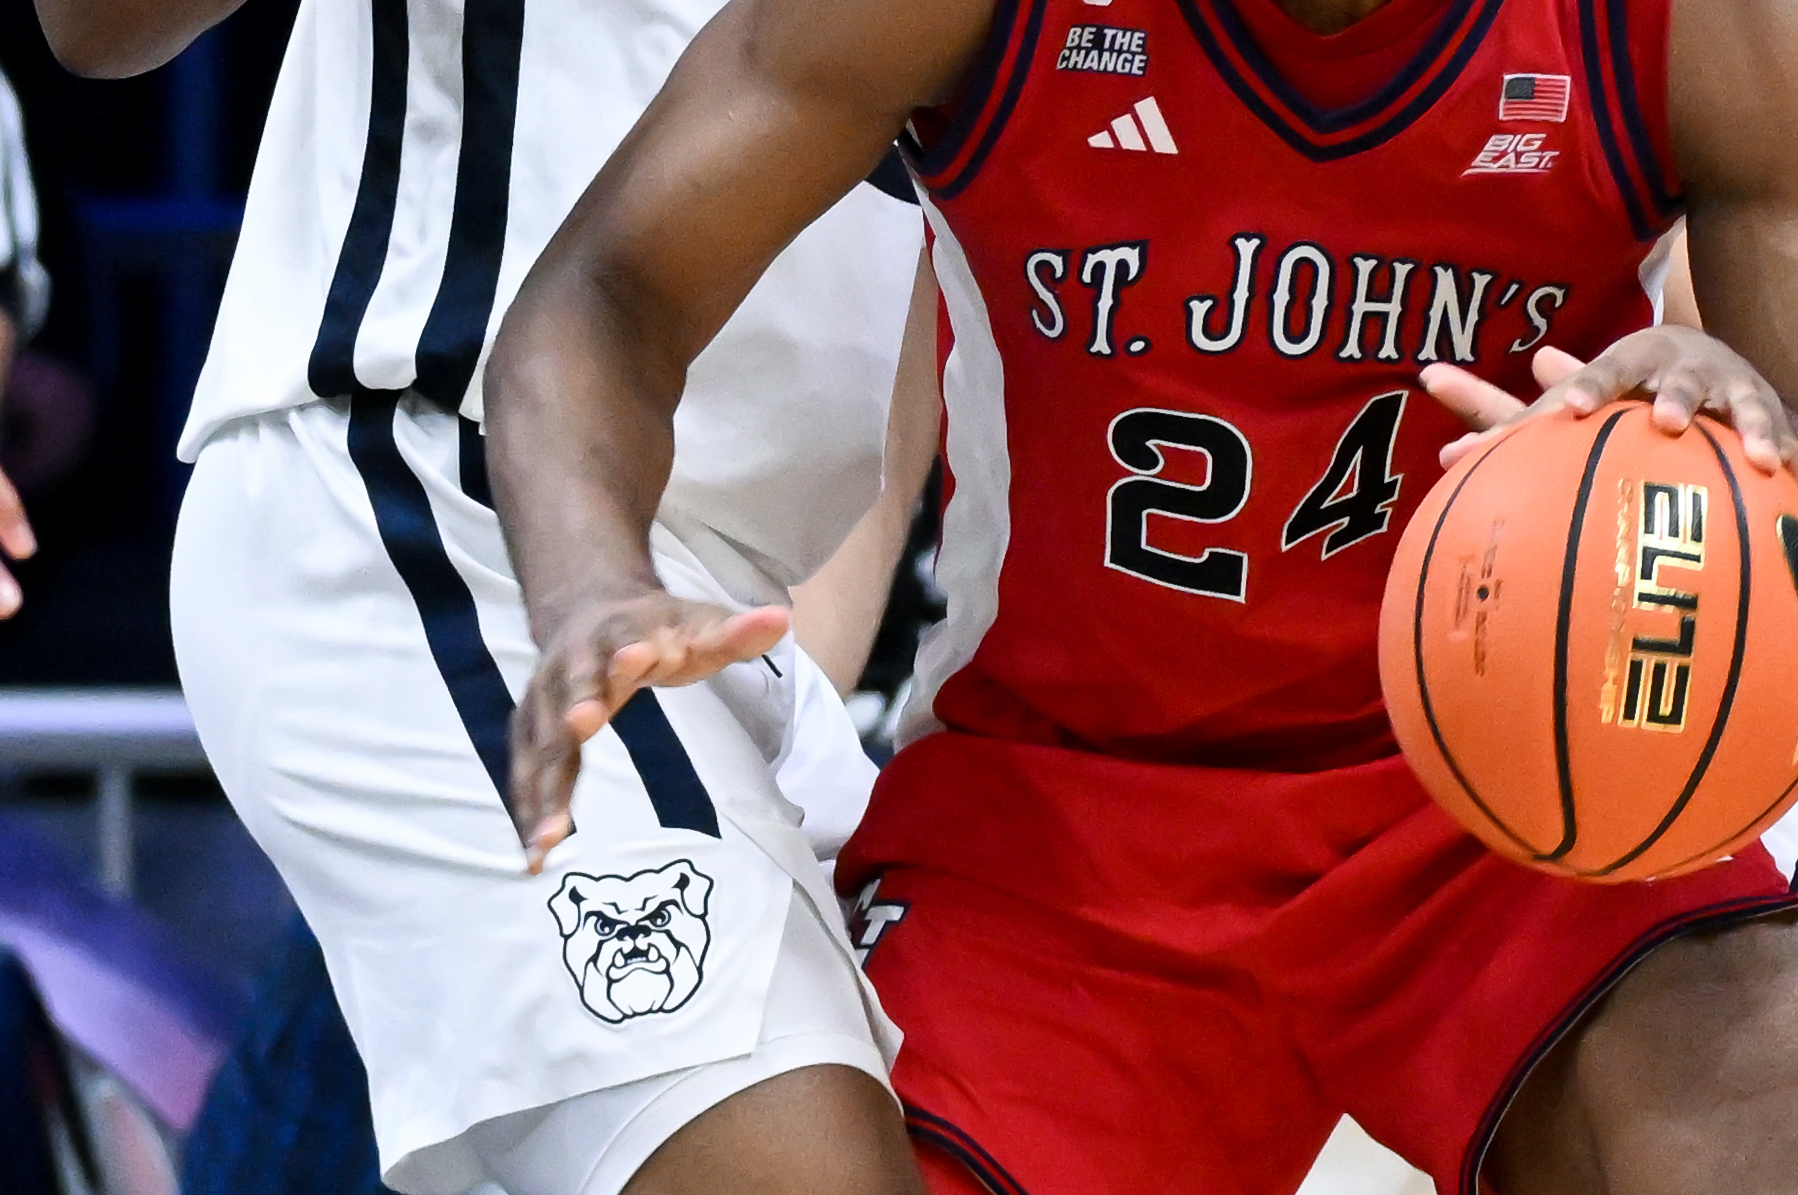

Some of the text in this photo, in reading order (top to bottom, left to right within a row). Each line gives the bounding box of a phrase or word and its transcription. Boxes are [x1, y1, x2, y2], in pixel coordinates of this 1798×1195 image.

[1066, 27, 1145, 52] BE THE
[1056, 49, 1147, 75] CHANGE
[1483, 133, 1546, 153] BIG
[1471, 151, 1560, 169] EAST
[1023, 232, 1569, 365] ST. JOHN'S
[1104, 390, 1409, 603] 24
[1617, 478, 1708, 734] ELITE
